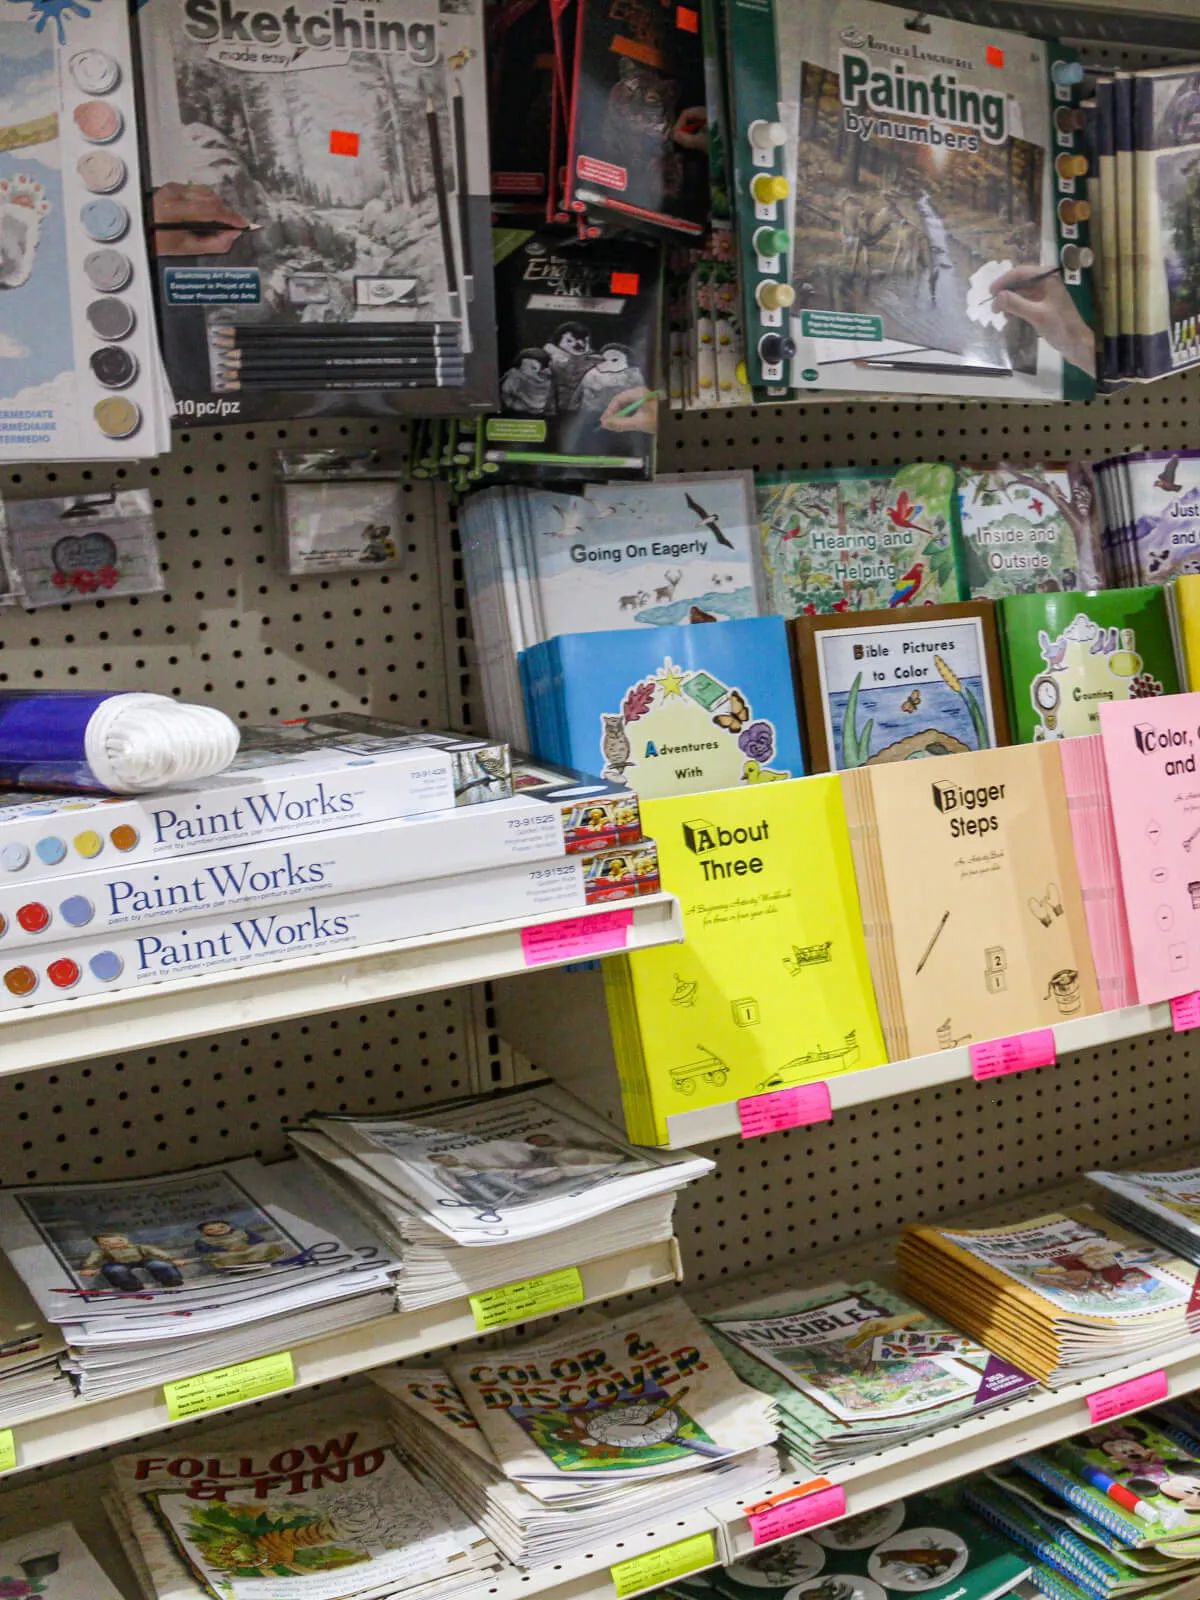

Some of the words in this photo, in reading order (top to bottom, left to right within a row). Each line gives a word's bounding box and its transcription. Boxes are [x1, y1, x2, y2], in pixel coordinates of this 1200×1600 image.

[185, 0, 435, 64] Sketching
[841, 52, 1006, 142] Painting
[845, 109, 873, 141] by
[879, 118, 978, 152] numbers
[1170, 502, 1199, 518] Just
[812, 532, 877, 551] Hearing
[883, 530, 914, 546] and
[977, 526, 1024, 544] Inside
[1028, 527, 1057, 542] and
[1171, 531, 1196, 545] and
[570, 543, 622, 563] Going
[626, 544, 648, 558] On
[652, 540, 708, 558] Eagerly
[989, 551, 1050, 570] Outside
[835, 562, 898, 581] Helping
[853, 643, 890, 661] Bible
[903, 639, 956, 655] Pictures
[873, 670, 886, 682] to
[894, 665, 929, 680] Color
[1073, 687, 1114, 702] Counting
[645, 738, 720, 760] Adventures
[1143, 727, 1194, 753] Color,
[674, 766, 703, 780] With
[1165, 754, 1196, 776] and
[942, 783, 1005, 812] Bigger
[697, 819, 770, 853] About
[950, 815, 999, 838] Steps
[699, 856, 764, 882] Three
[468, 1348, 615, 1387] COLOR
[623, 1331, 662, 1362] &
[477, 1346, 710, 1410] DISCOVER
[133, 1431, 360, 1481] FOLLOW
[184, 1478, 235, 1503] &
[253, 1449, 387, 1500] FIND
